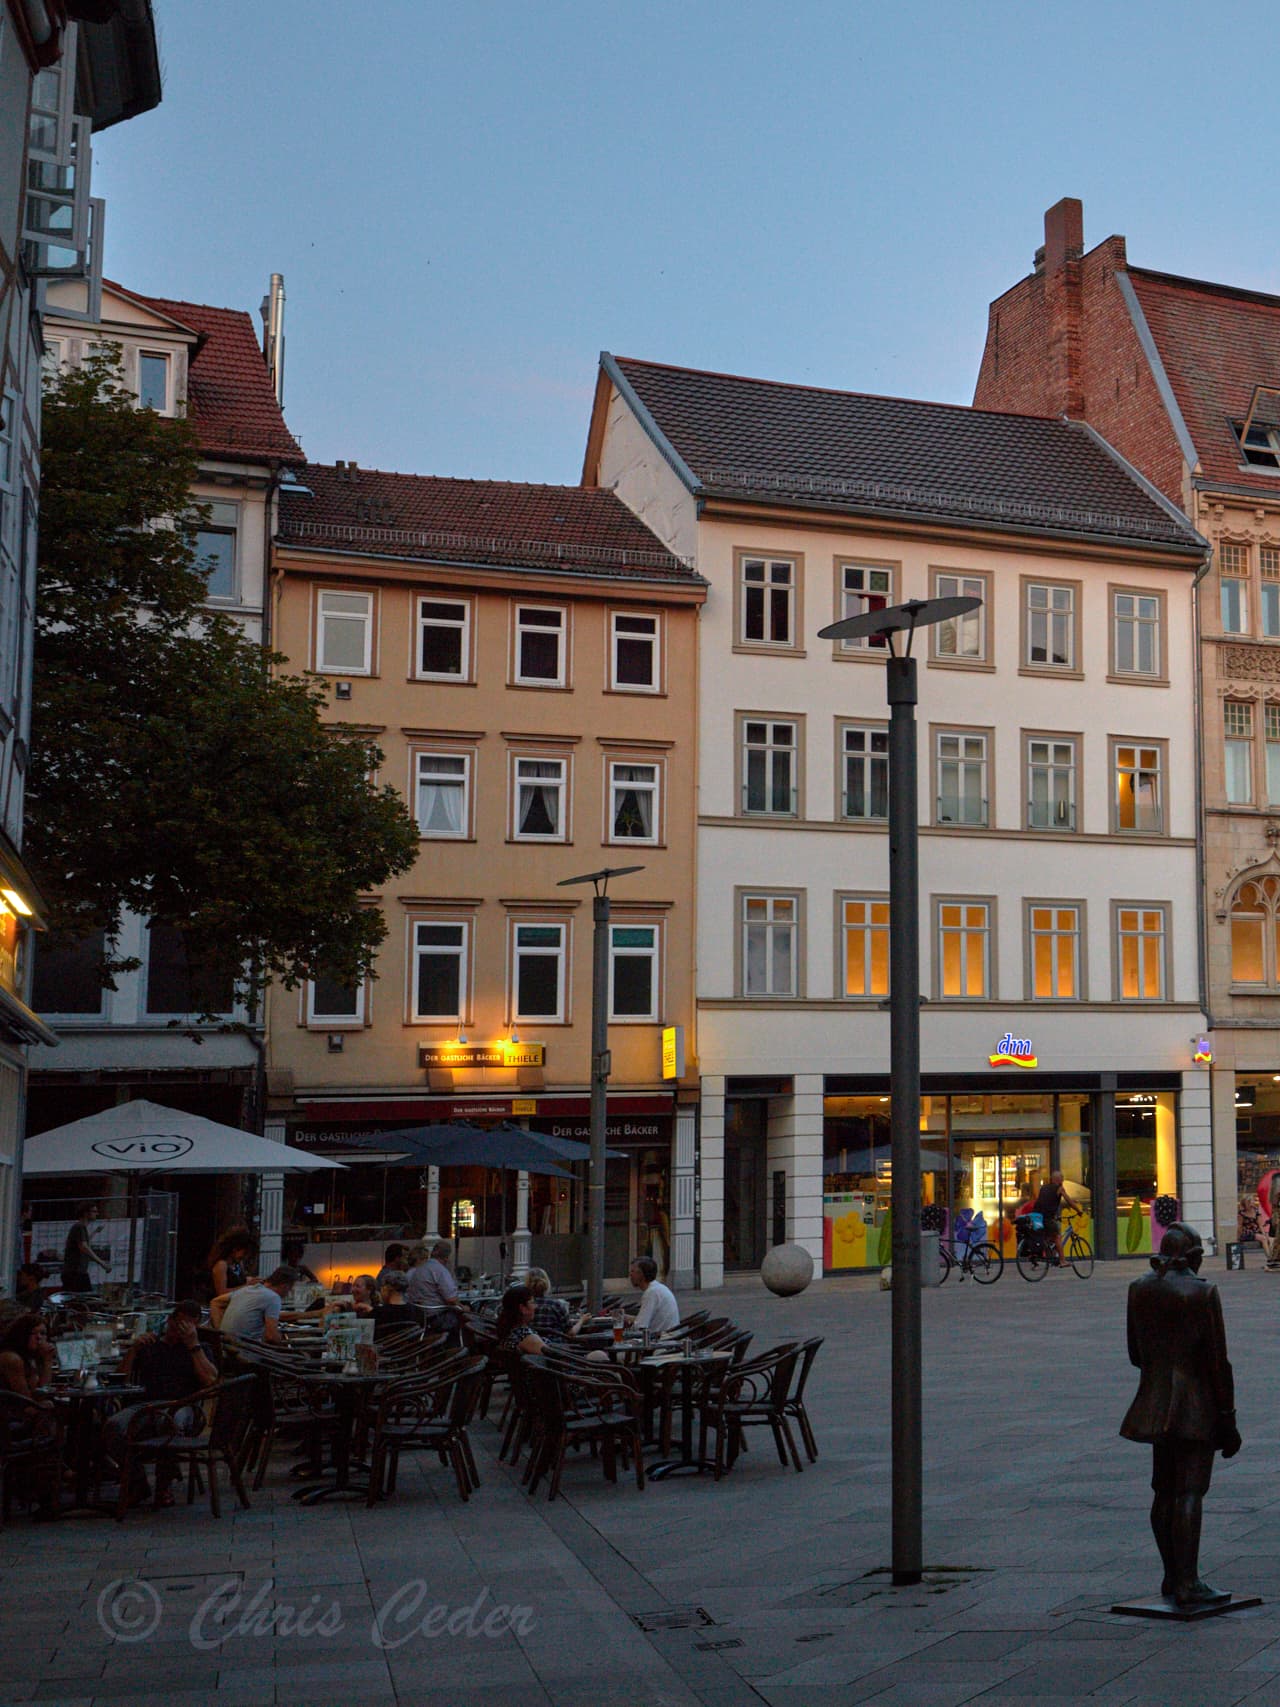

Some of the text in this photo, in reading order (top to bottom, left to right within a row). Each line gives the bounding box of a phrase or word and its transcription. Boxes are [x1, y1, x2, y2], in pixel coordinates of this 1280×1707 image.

[997, 1033, 1032, 1055] dm
[508, 1055, 539, 1063] THIELE
[574, 1127, 621, 1136] GASCHE
